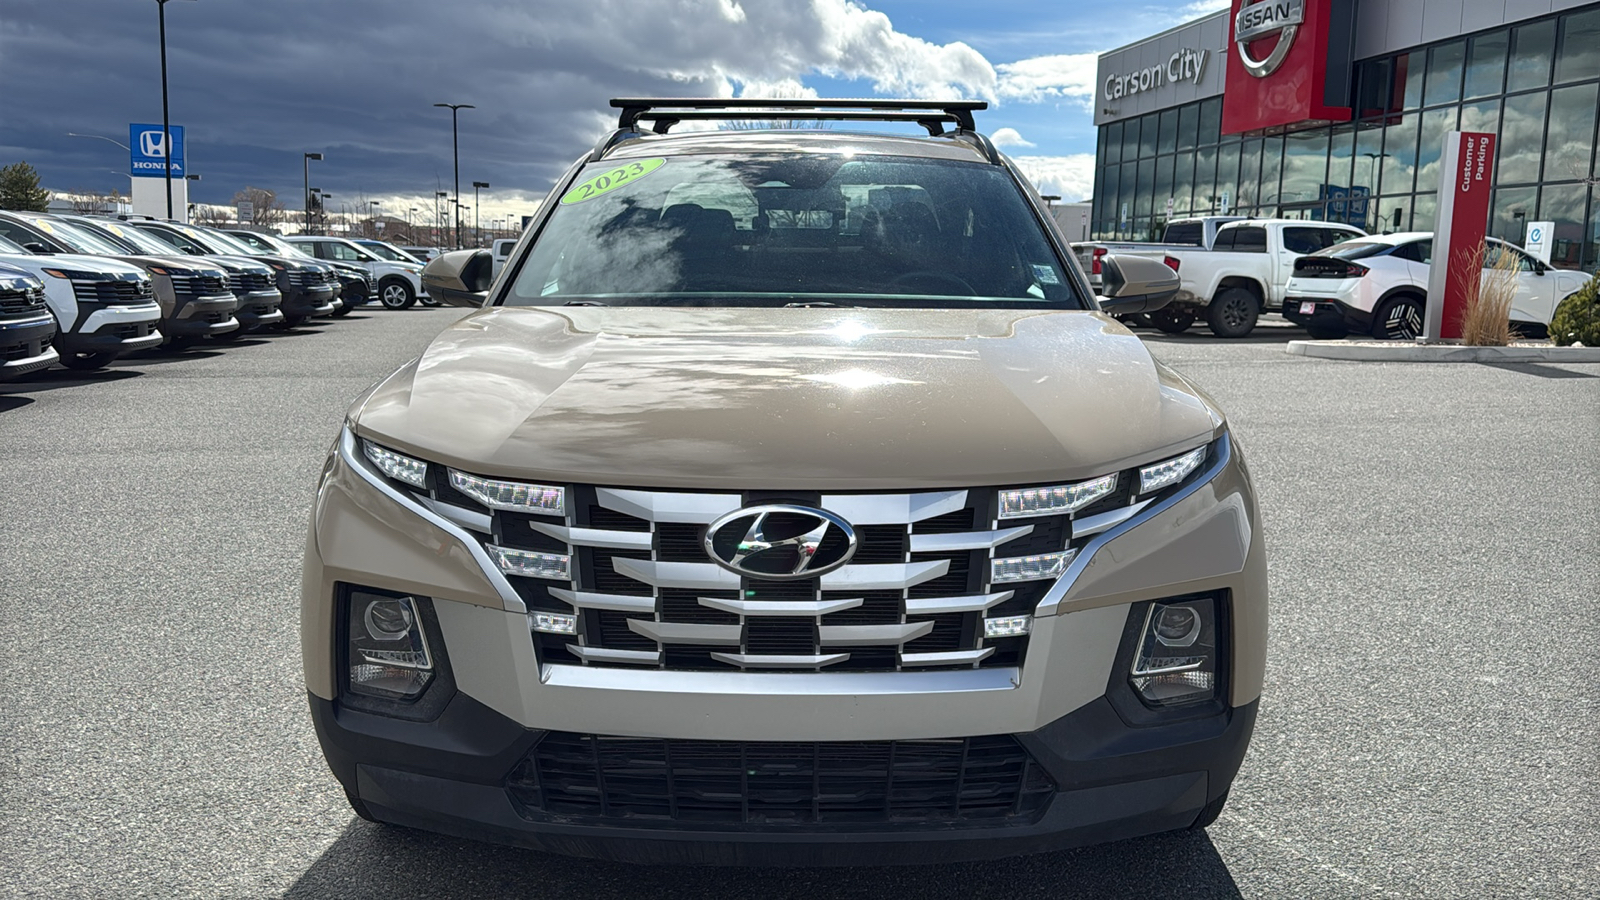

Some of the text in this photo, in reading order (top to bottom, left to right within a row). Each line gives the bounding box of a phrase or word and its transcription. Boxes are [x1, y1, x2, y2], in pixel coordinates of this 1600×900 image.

[1239, 2, 1290, 33] NISSAN
[1104, 48, 1208, 101] Carson City
[578, 162, 645, 199] 2023
[1461, 136, 1474, 192] Customer
[1475, 137, 1489, 181] Parking
